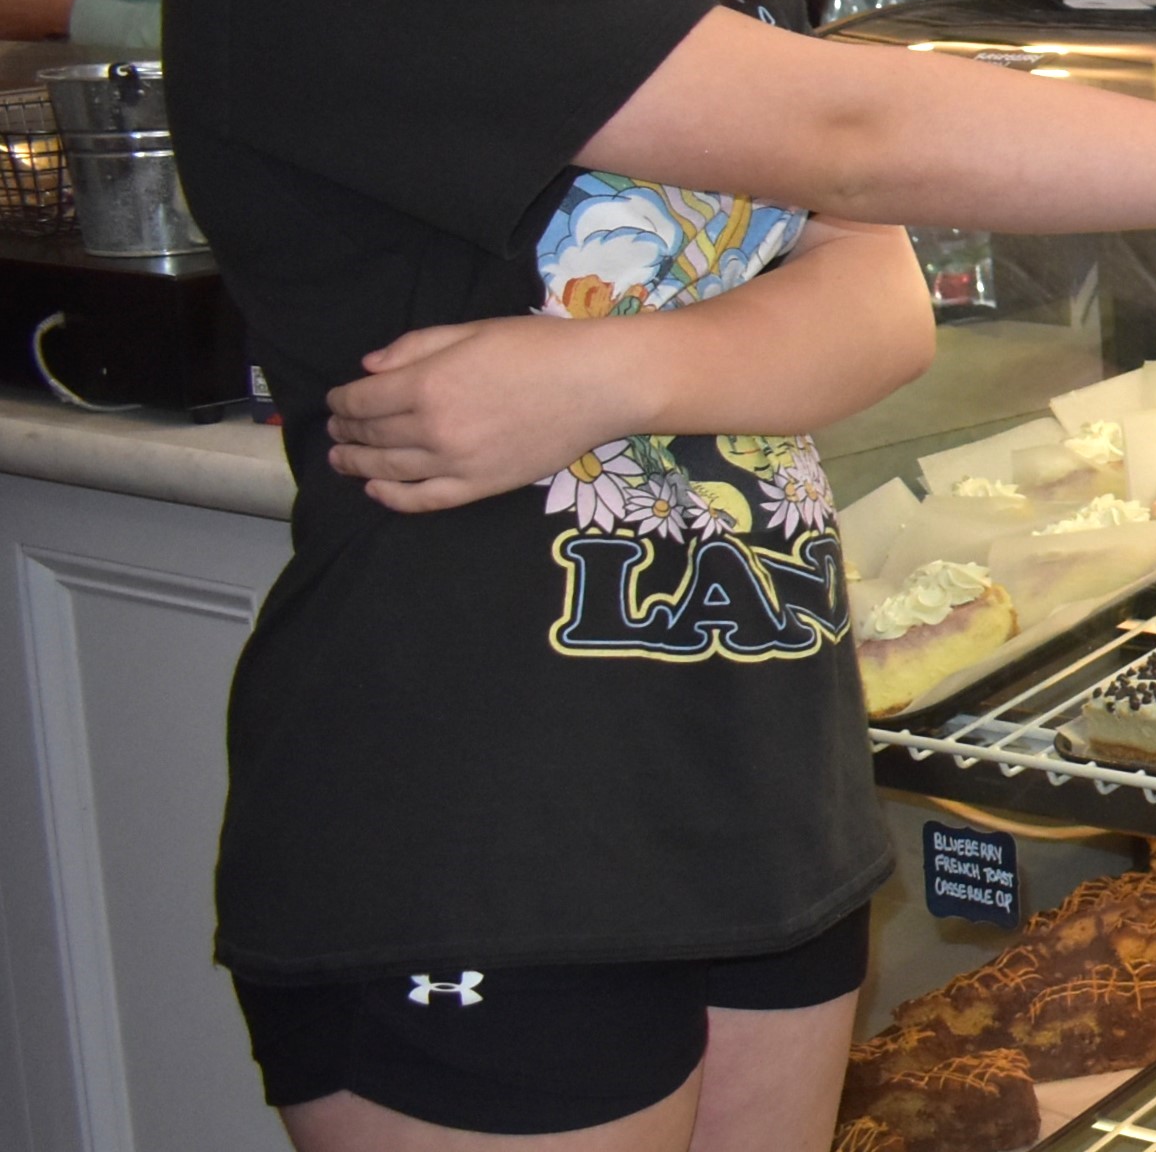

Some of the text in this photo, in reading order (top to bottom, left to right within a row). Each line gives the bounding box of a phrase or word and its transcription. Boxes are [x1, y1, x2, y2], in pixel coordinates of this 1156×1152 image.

[934, 831, 1002, 865] BLUEBERRY
[935, 853, 1014, 888] FRENCH TOAST
